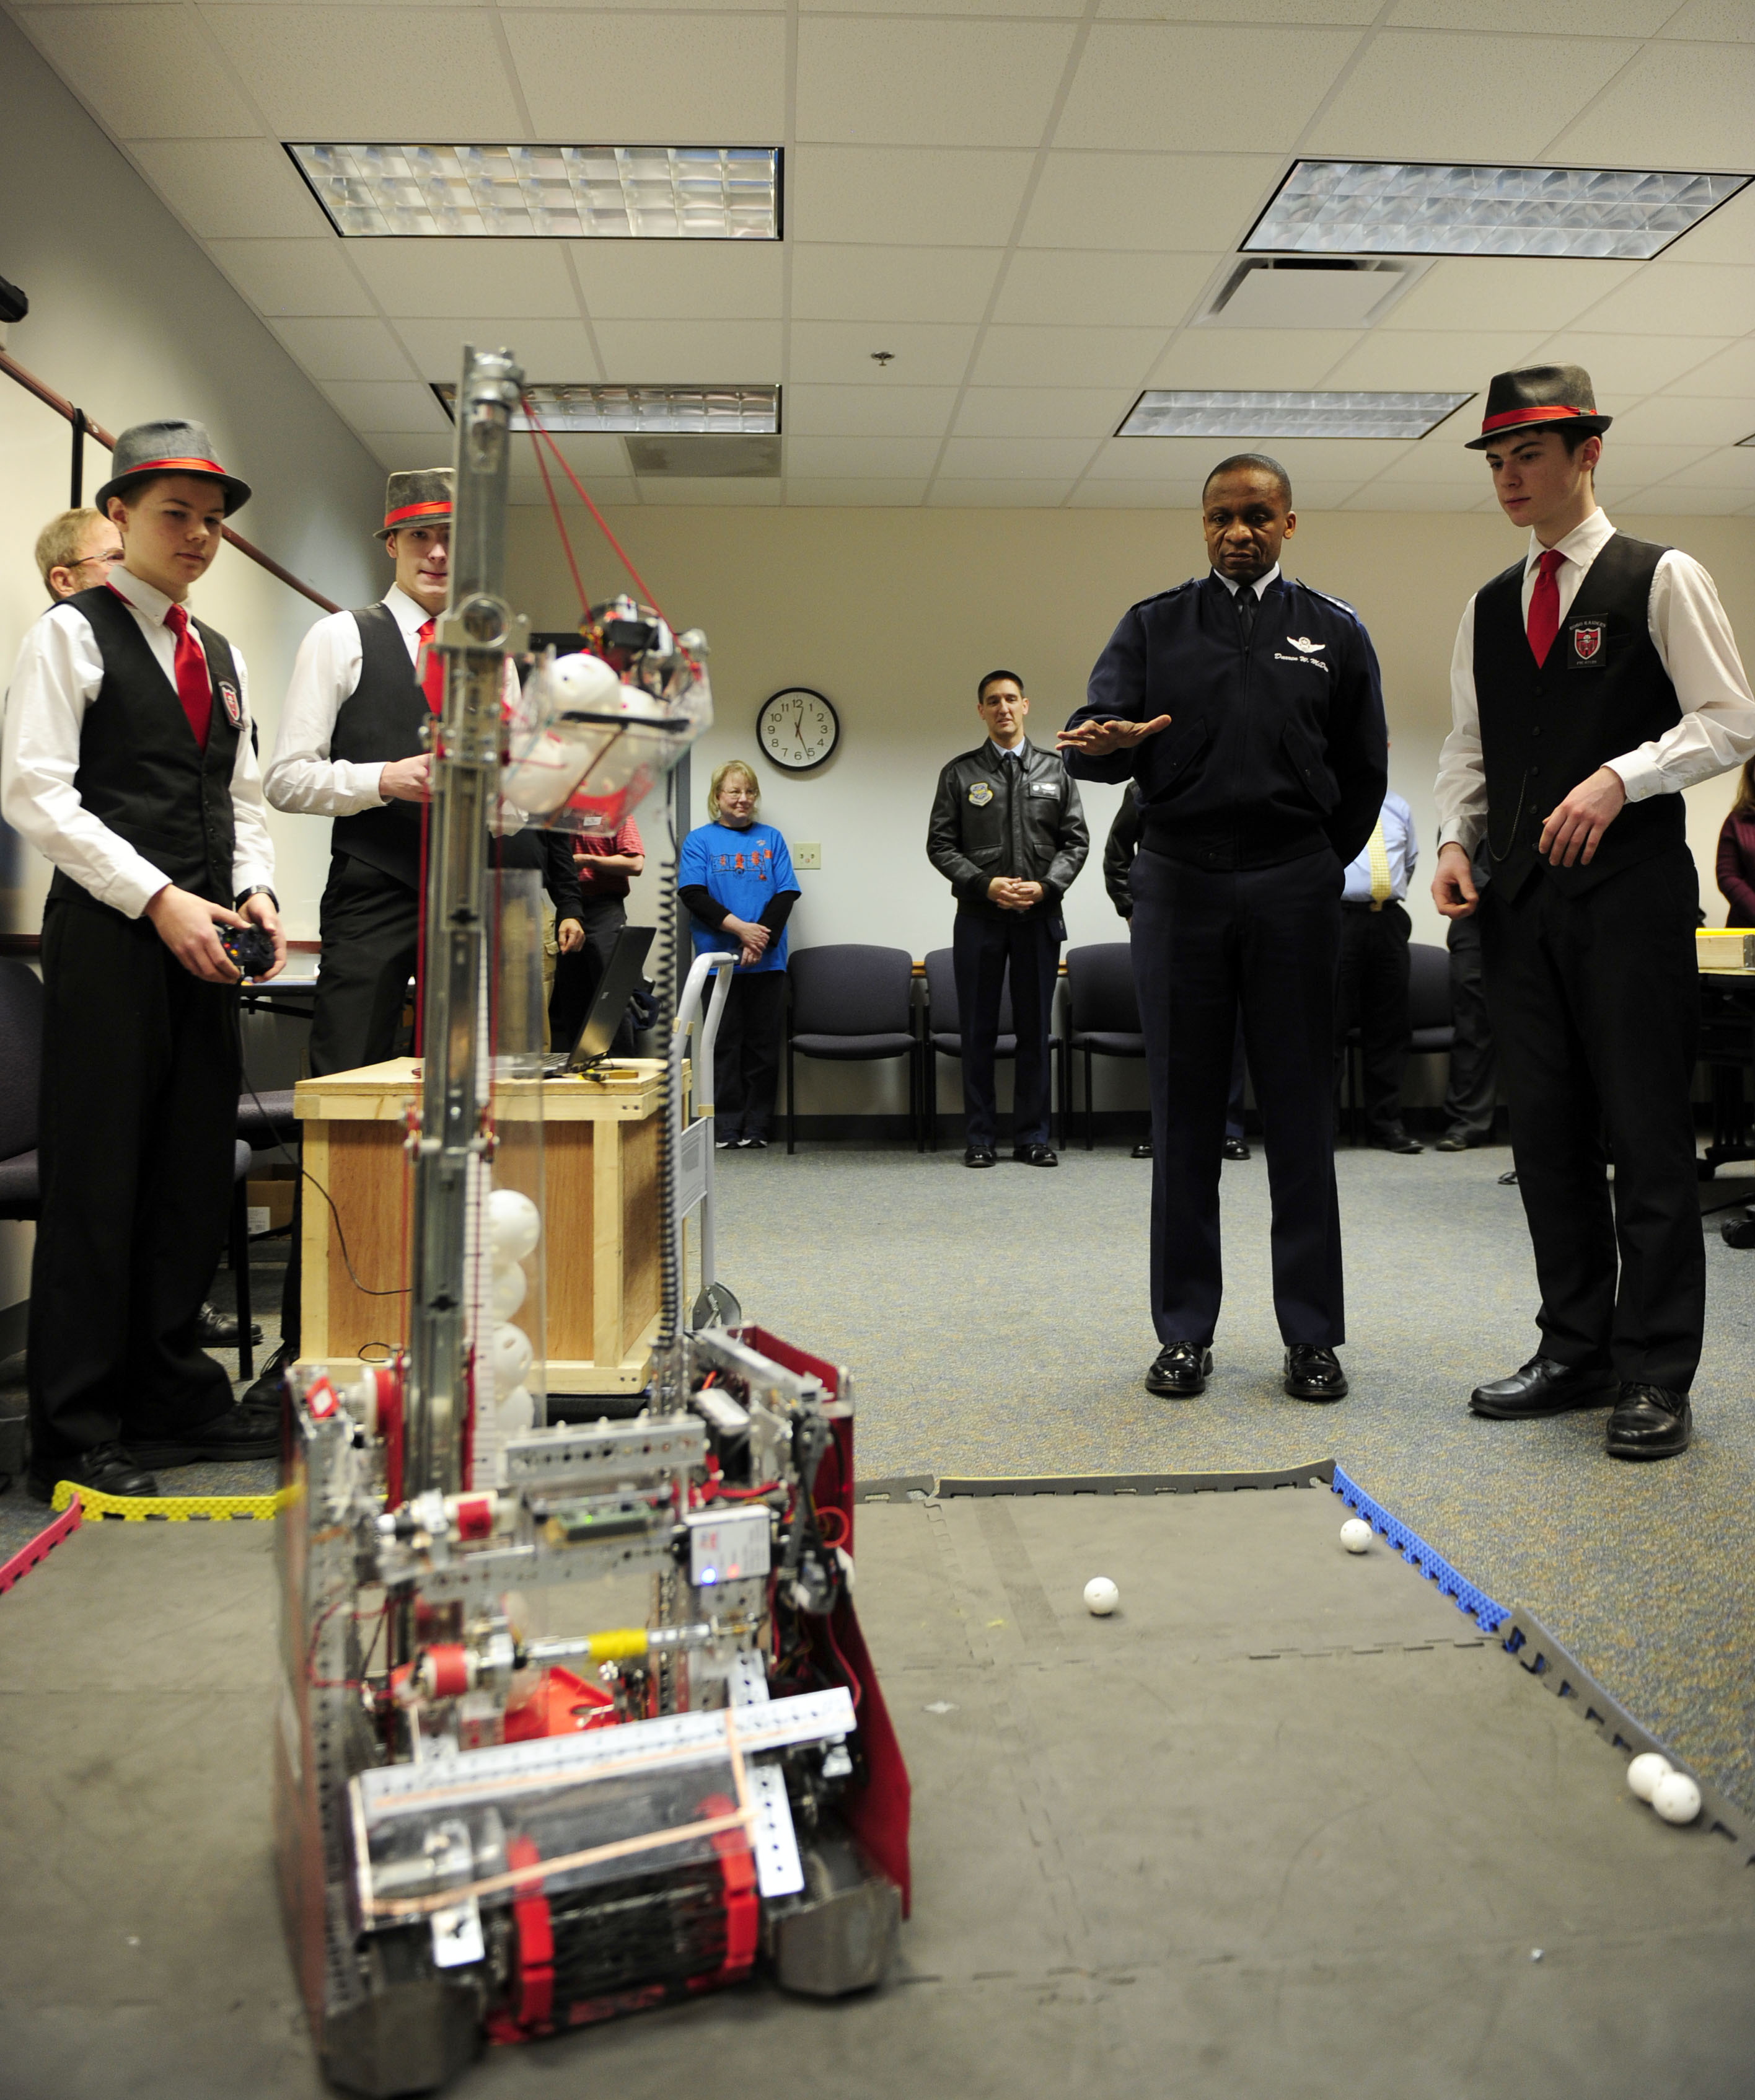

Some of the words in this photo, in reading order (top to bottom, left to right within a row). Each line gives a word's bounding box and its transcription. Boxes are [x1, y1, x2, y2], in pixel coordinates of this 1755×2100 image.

[781, 704, 789, 712] 11
[792, 699, 803, 708] 12
[809, 704, 813, 712] 1
[771, 713, 782, 722] 10
[817, 713, 824, 722] 2
[767, 725, 775, 734] 9
[820, 725, 828, 734] 3
[772, 739, 779, 748] 8
[817, 739, 824, 747] 4
[781, 748, 788, 757] 7
[794, 751, 802, 760] 6
[807, 748, 815, 757] 5
